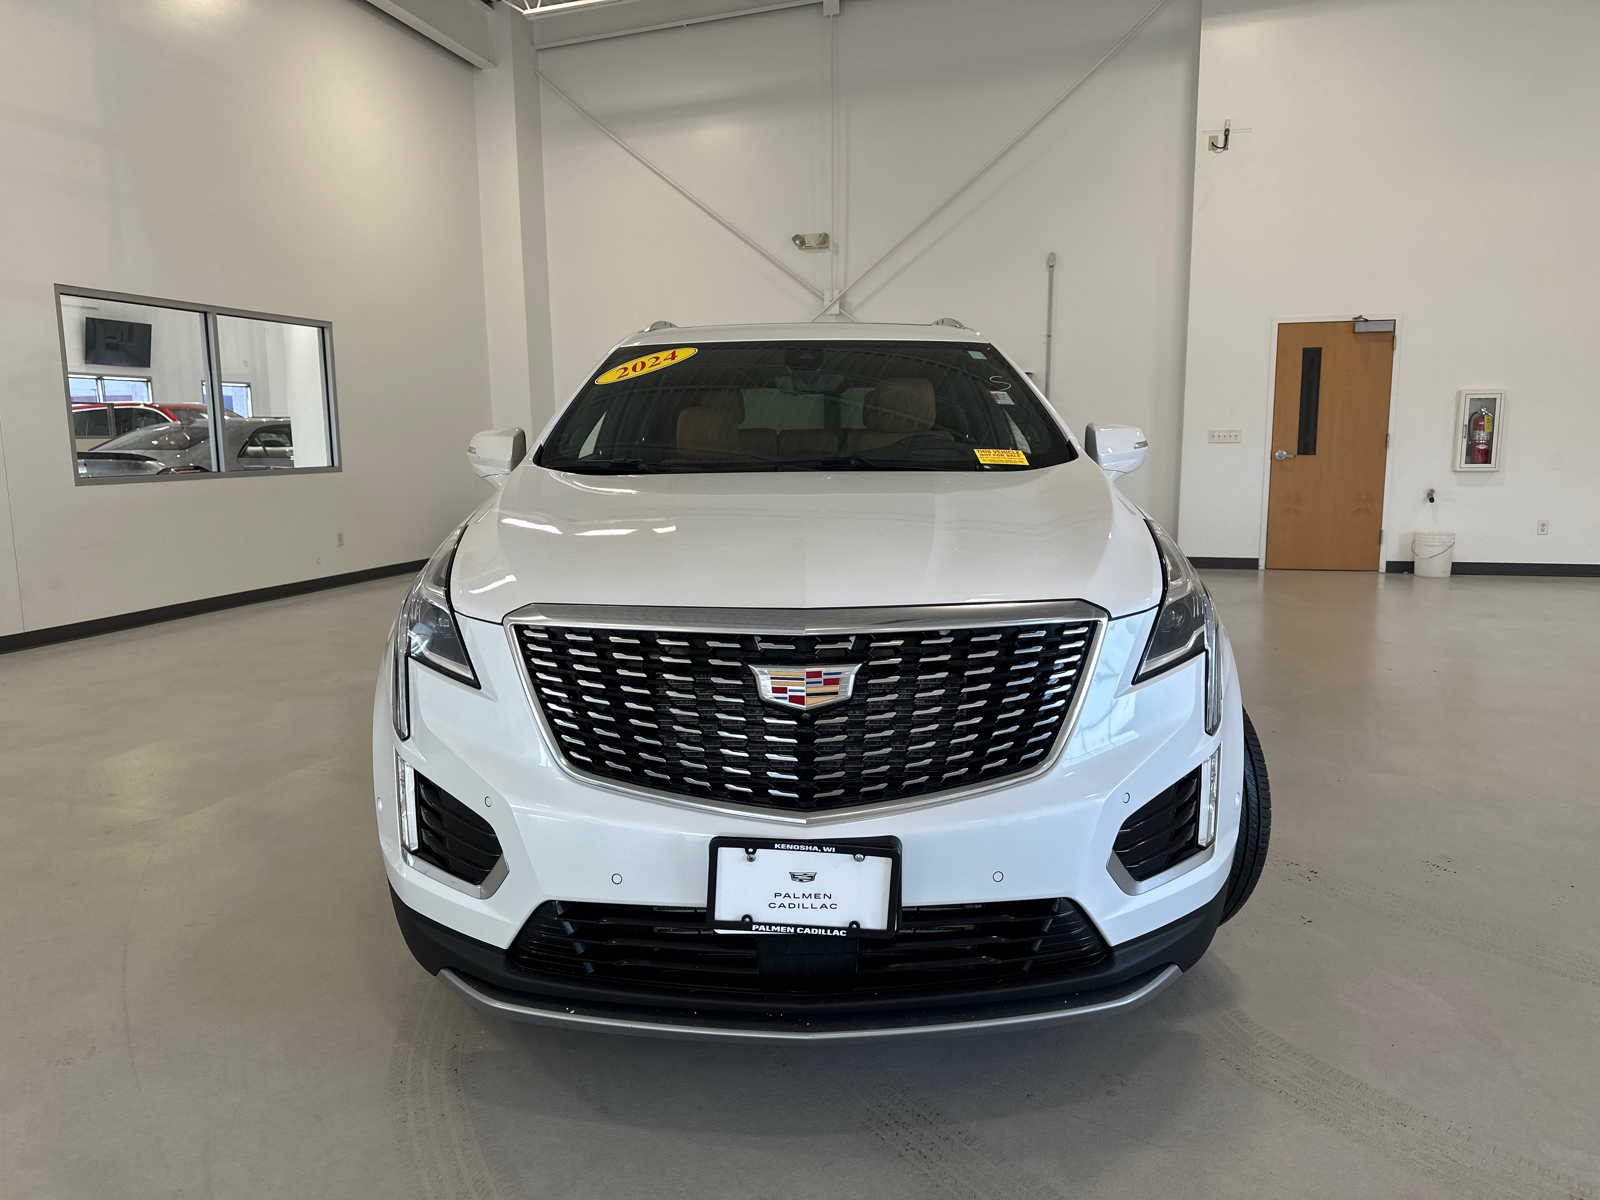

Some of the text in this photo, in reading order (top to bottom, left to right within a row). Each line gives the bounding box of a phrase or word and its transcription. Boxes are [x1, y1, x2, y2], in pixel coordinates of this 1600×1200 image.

[615, 349, 678, 380] 2024
[774, 892, 832, 900] PALMEN
[768, 902, 838, 910] CADILLAC
[752, 924, 847, 936] PALMEN CADILLAC
